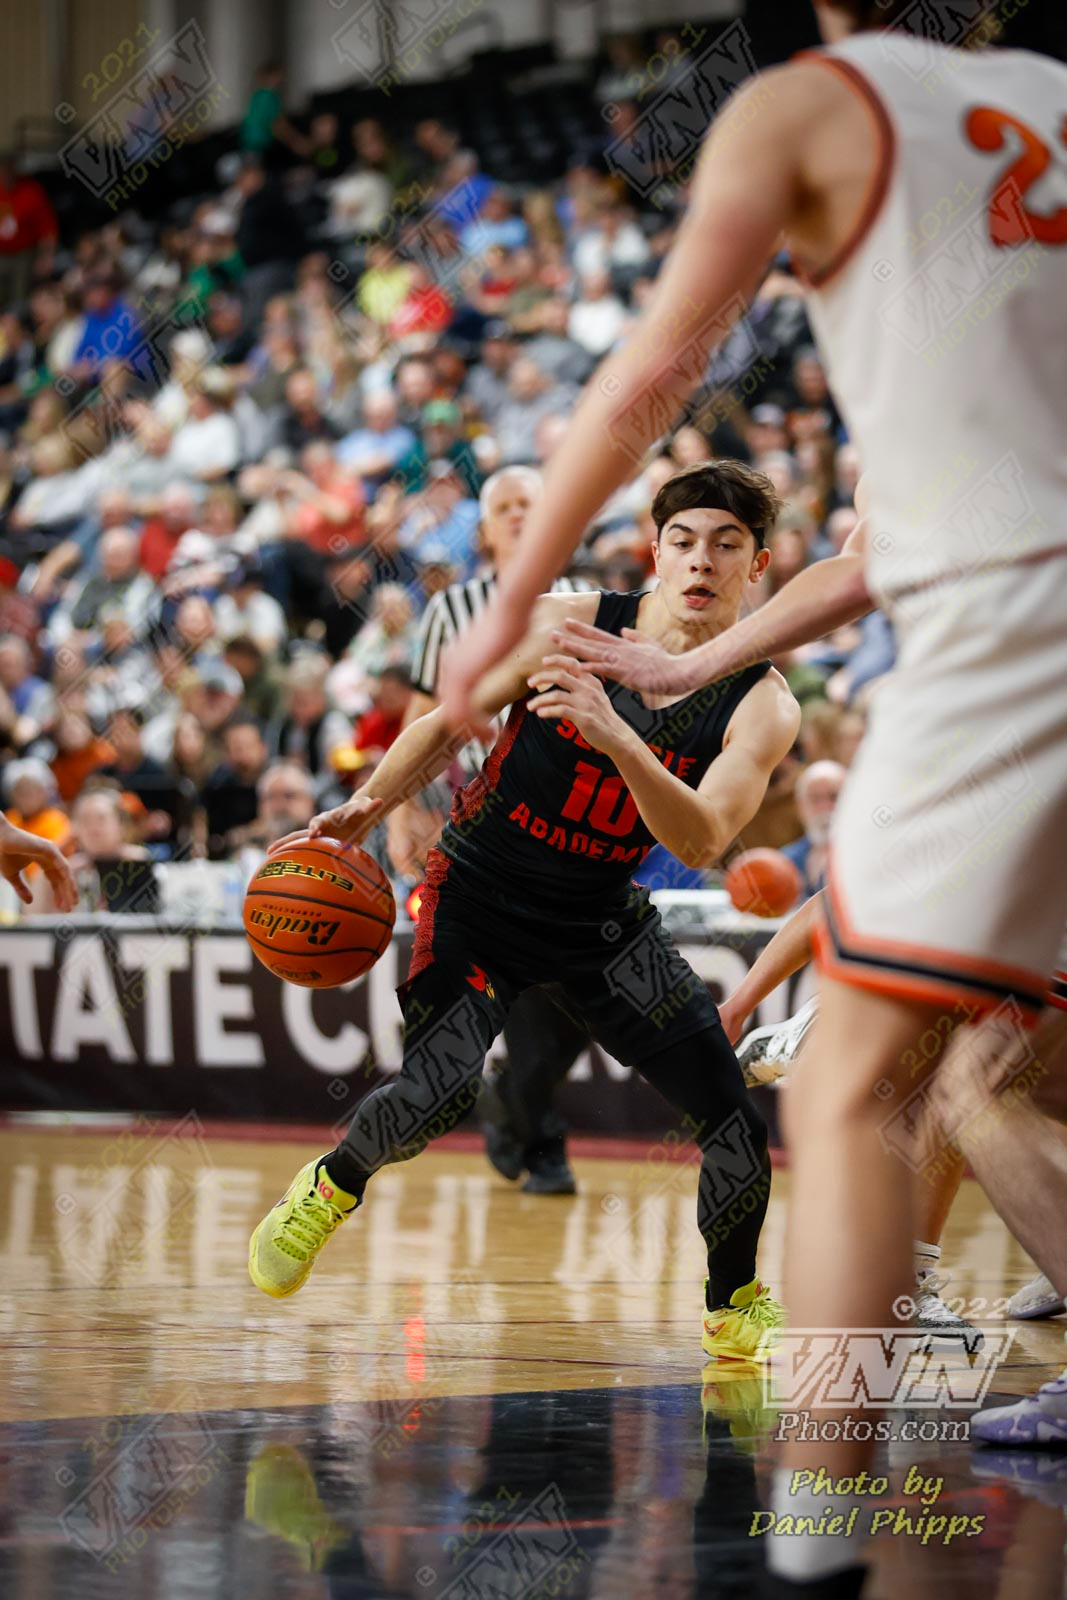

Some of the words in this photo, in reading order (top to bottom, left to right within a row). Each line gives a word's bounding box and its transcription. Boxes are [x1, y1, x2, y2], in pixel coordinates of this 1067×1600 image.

[964, 104, 1067, 246] 2
[559, 760, 640, 838] 10
[283, 861, 355, 893] ELITE
[249, 908, 341, 946] Baden
